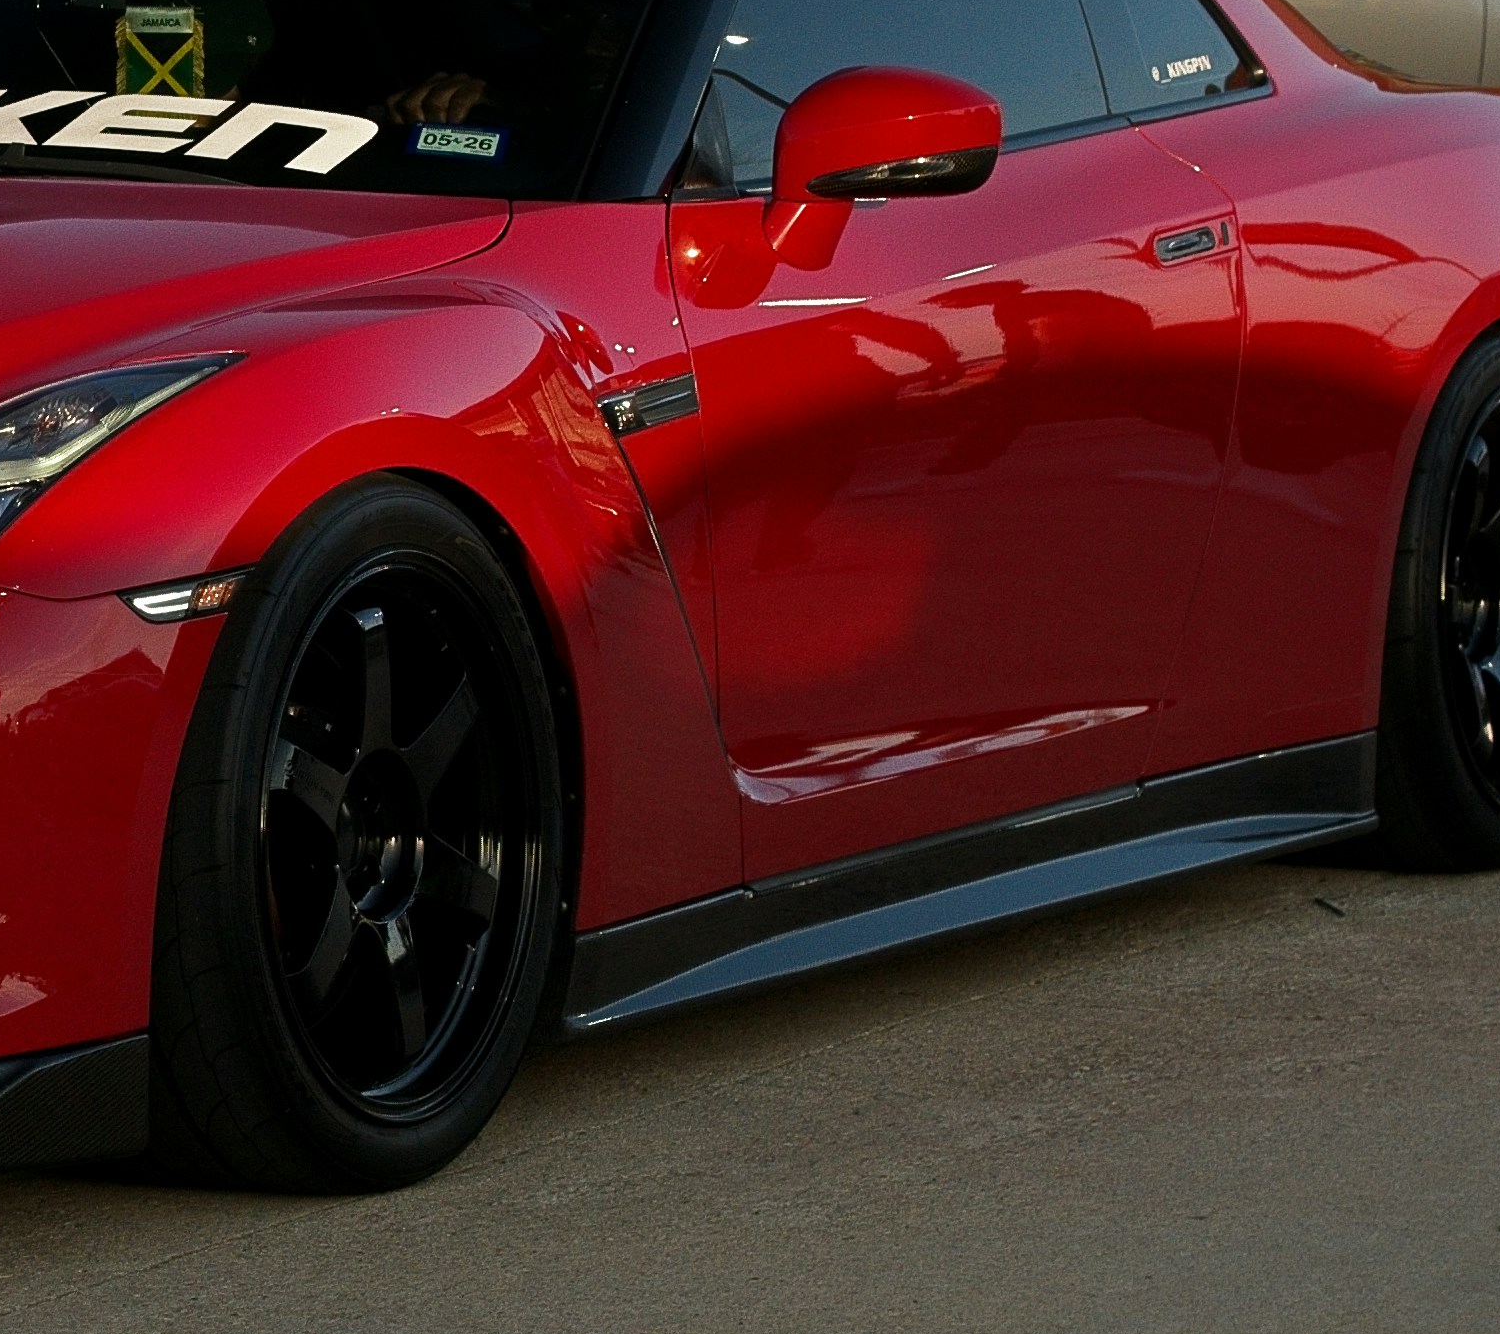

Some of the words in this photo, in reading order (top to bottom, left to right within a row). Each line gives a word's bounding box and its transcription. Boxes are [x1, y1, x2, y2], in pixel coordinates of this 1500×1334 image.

[141, 18, 181, 27] JAMAICA
[1151, 54, 1212, 83] @_KINGPIN
[424, 133, 453, 146] 05
[463, 137, 494, 150] 26
